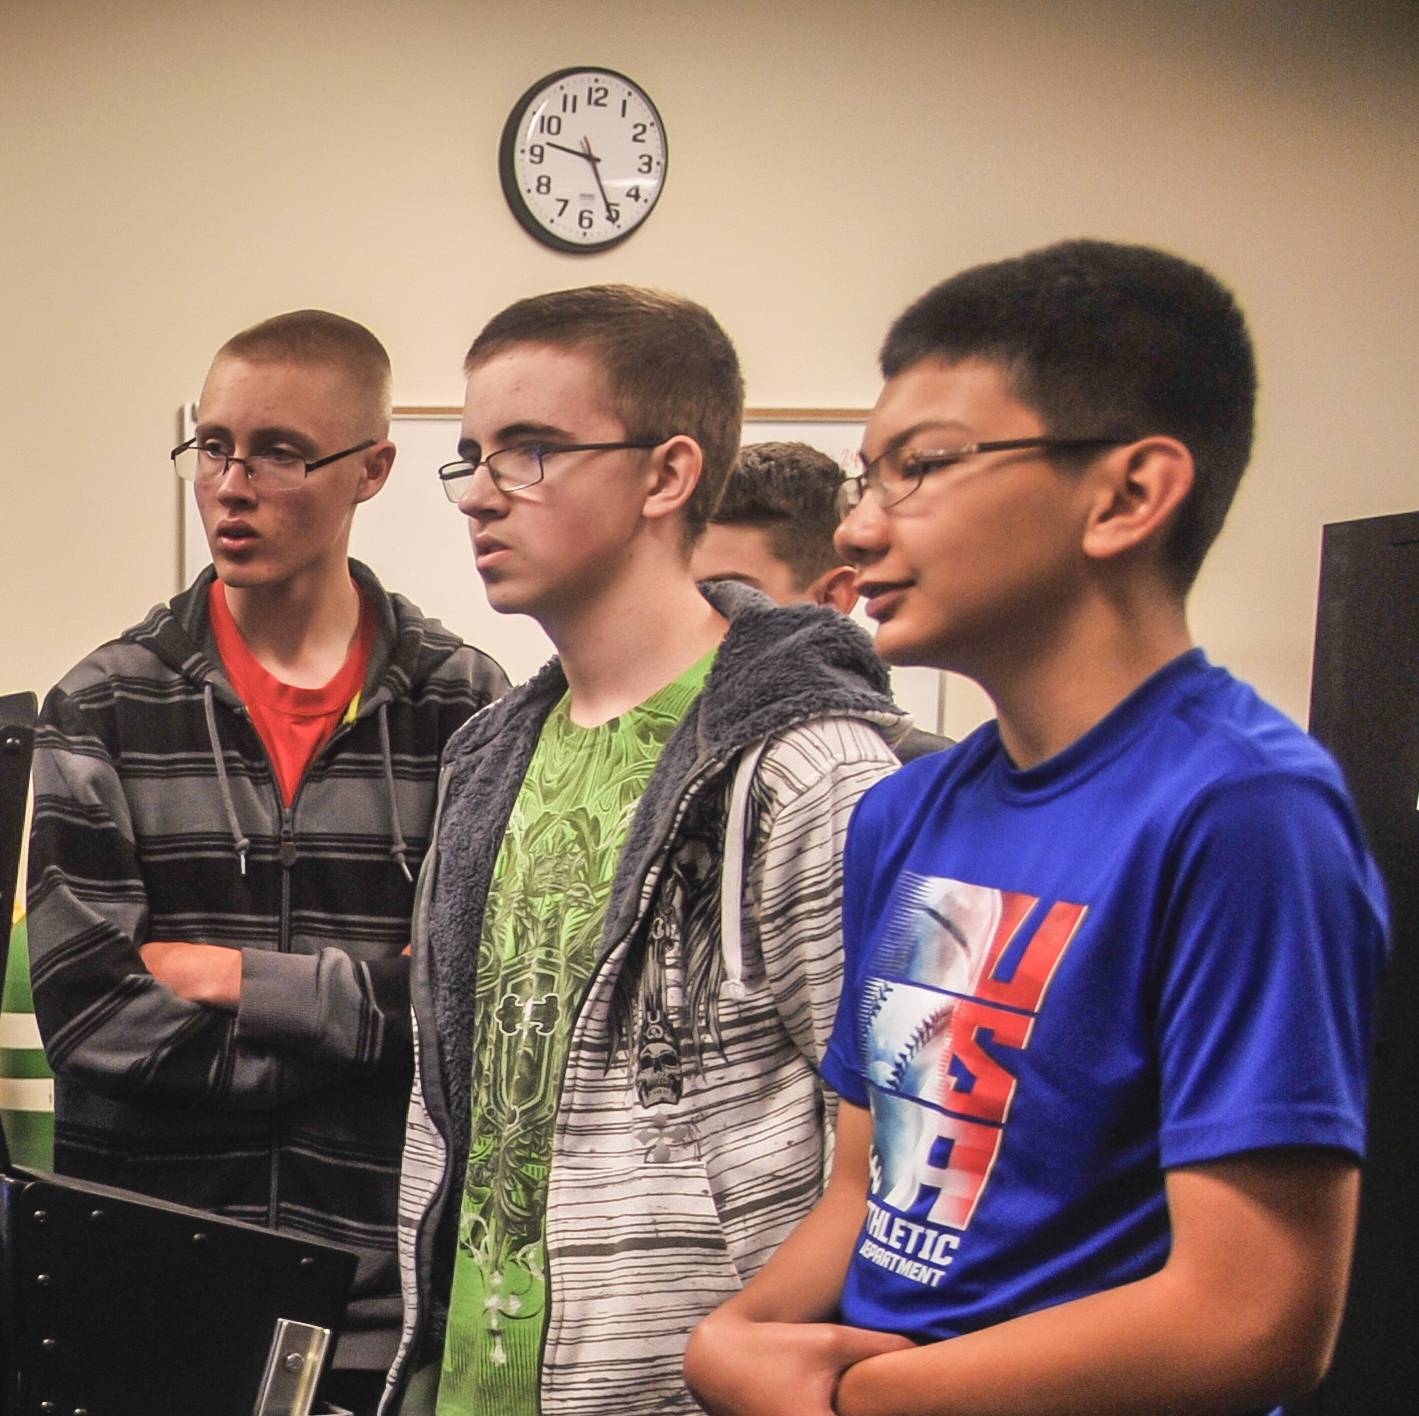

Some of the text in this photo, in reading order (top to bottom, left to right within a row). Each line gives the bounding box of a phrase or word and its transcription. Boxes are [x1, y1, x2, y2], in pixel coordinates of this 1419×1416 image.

[562, 93, 578, 114] 11
[587, 87, 609, 108] 12
[621, 99, 628, 118] 1
[539, 115, 562, 136] 10
[631, 122, 647, 143] 2
[529, 143, 544, 165] 9
[637, 153, 653, 174] 3
[536, 174, 551, 195] 8
[625, 185, 642, 203] 4
[555, 198, 569, 217] 7
[605, 202, 621, 223] 5
[578, 209, 594, 230] 6
[866, 1199, 961, 1266] THLETIC
